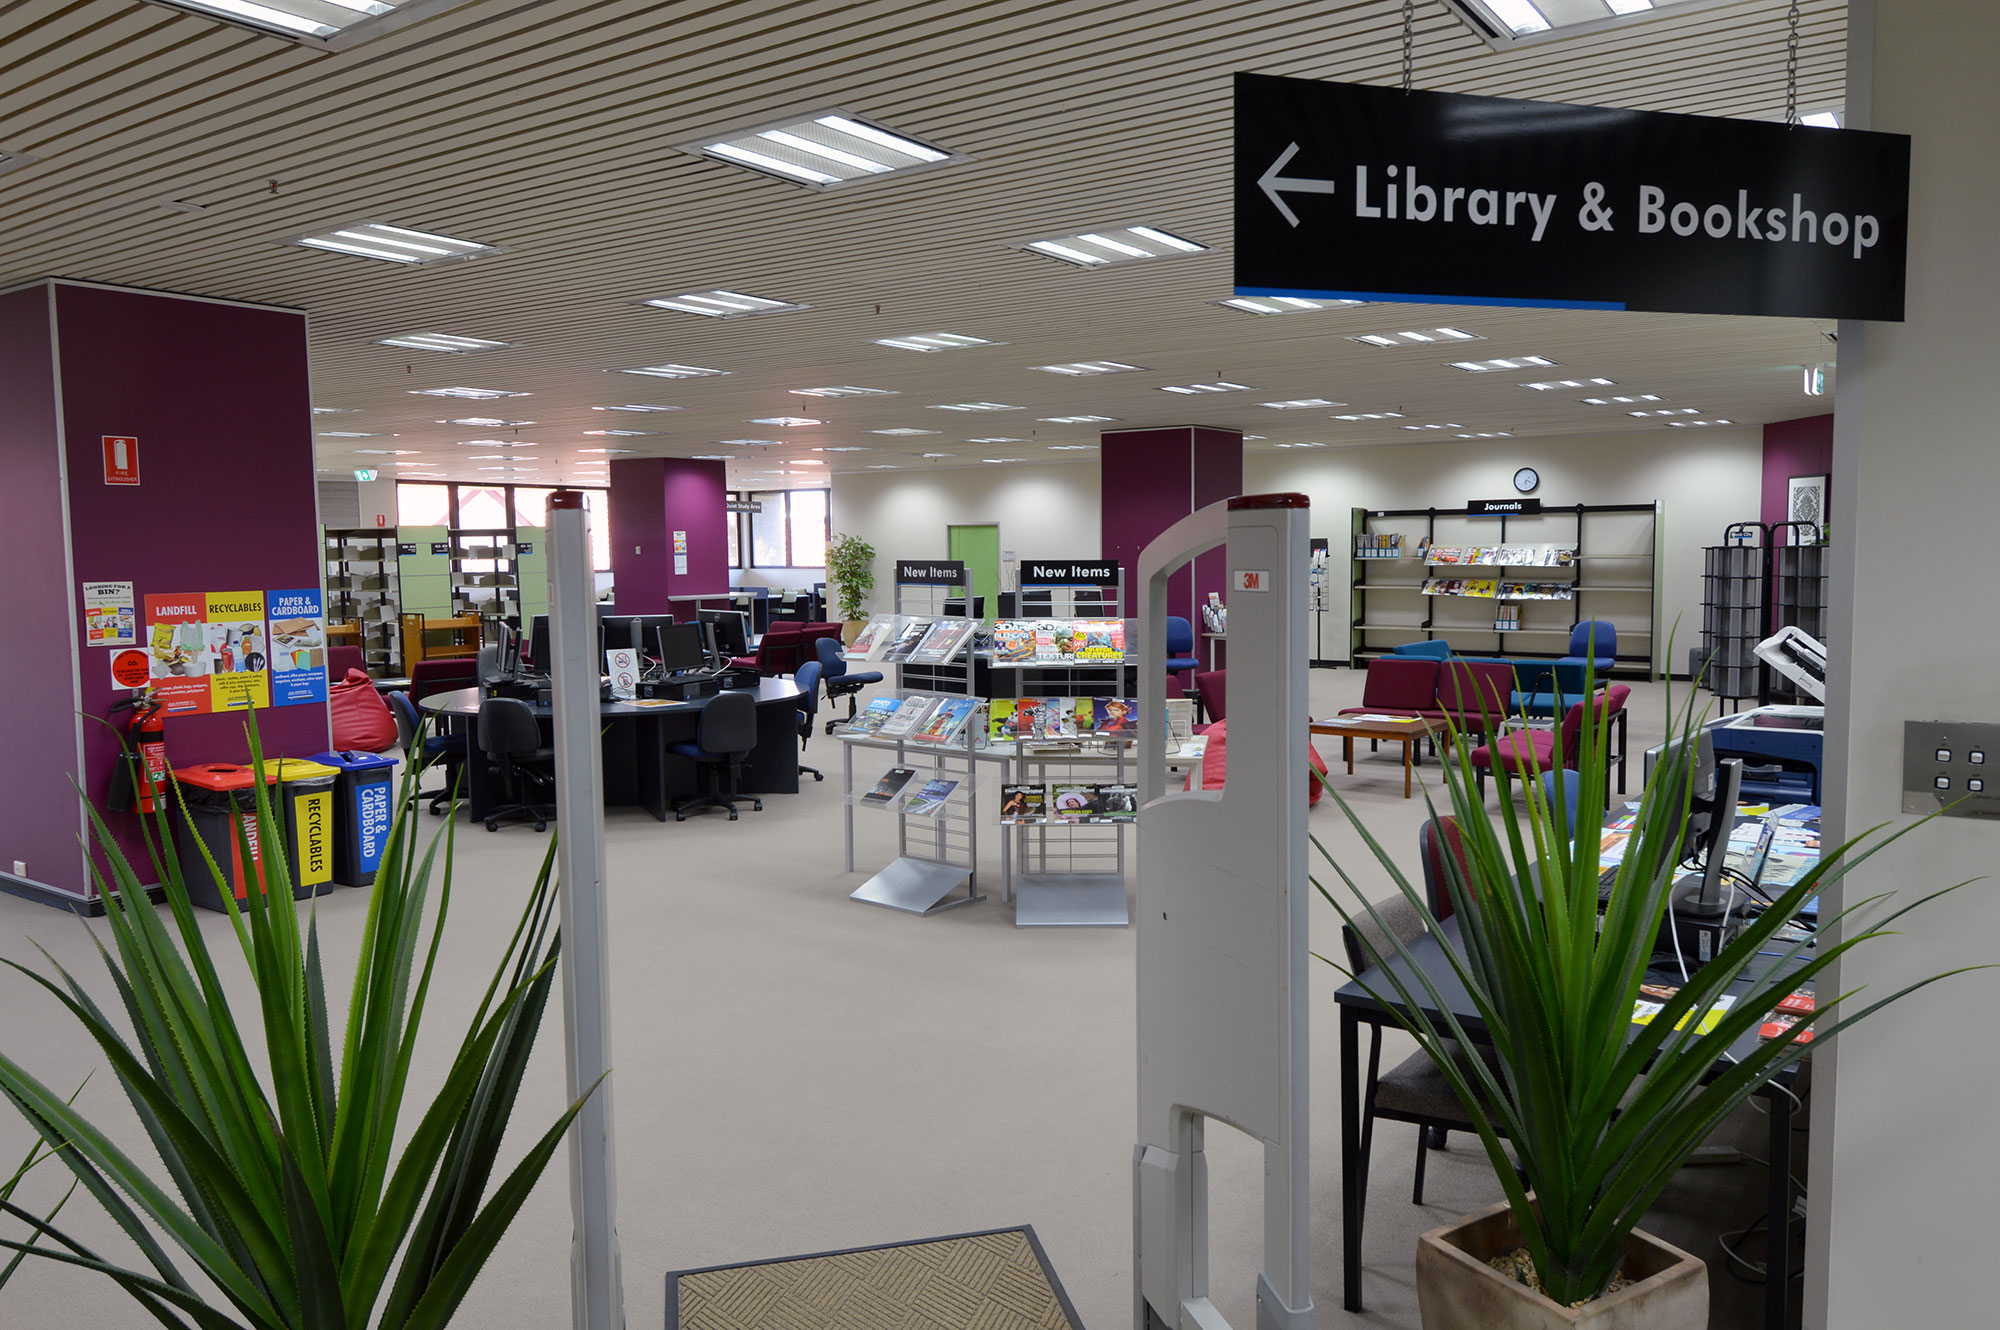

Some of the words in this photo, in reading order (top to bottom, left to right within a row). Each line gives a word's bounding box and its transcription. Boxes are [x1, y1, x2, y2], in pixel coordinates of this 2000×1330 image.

[1355, 164, 1557, 242] Library
[1577, 181, 1615, 232] &
[1637, 184, 1880, 260] Bookshop
[1484, 502, 1522, 512] Journals
[903, 566, 927, 578] New
[929, 566, 958, 578] Items
[1033, 565, 1067, 578] New
[1071, 565, 1111, 578] Items
[1243, 572, 1260, 590] 3M
[278, 596, 304, 607] PAPER
[304, 596, 311, 605] &
[155, 605, 197, 617] LANDFILL
[208, 602, 262, 614] RECYCLABLES
[271, 605, 319, 616] CARDBOARD
[374, 786, 387, 819] PAPER
[361, 788, 376, 858] CARDBOARD
[375, 823, 387, 834] &
[308, 798, 323, 873] RECYCLABLES
